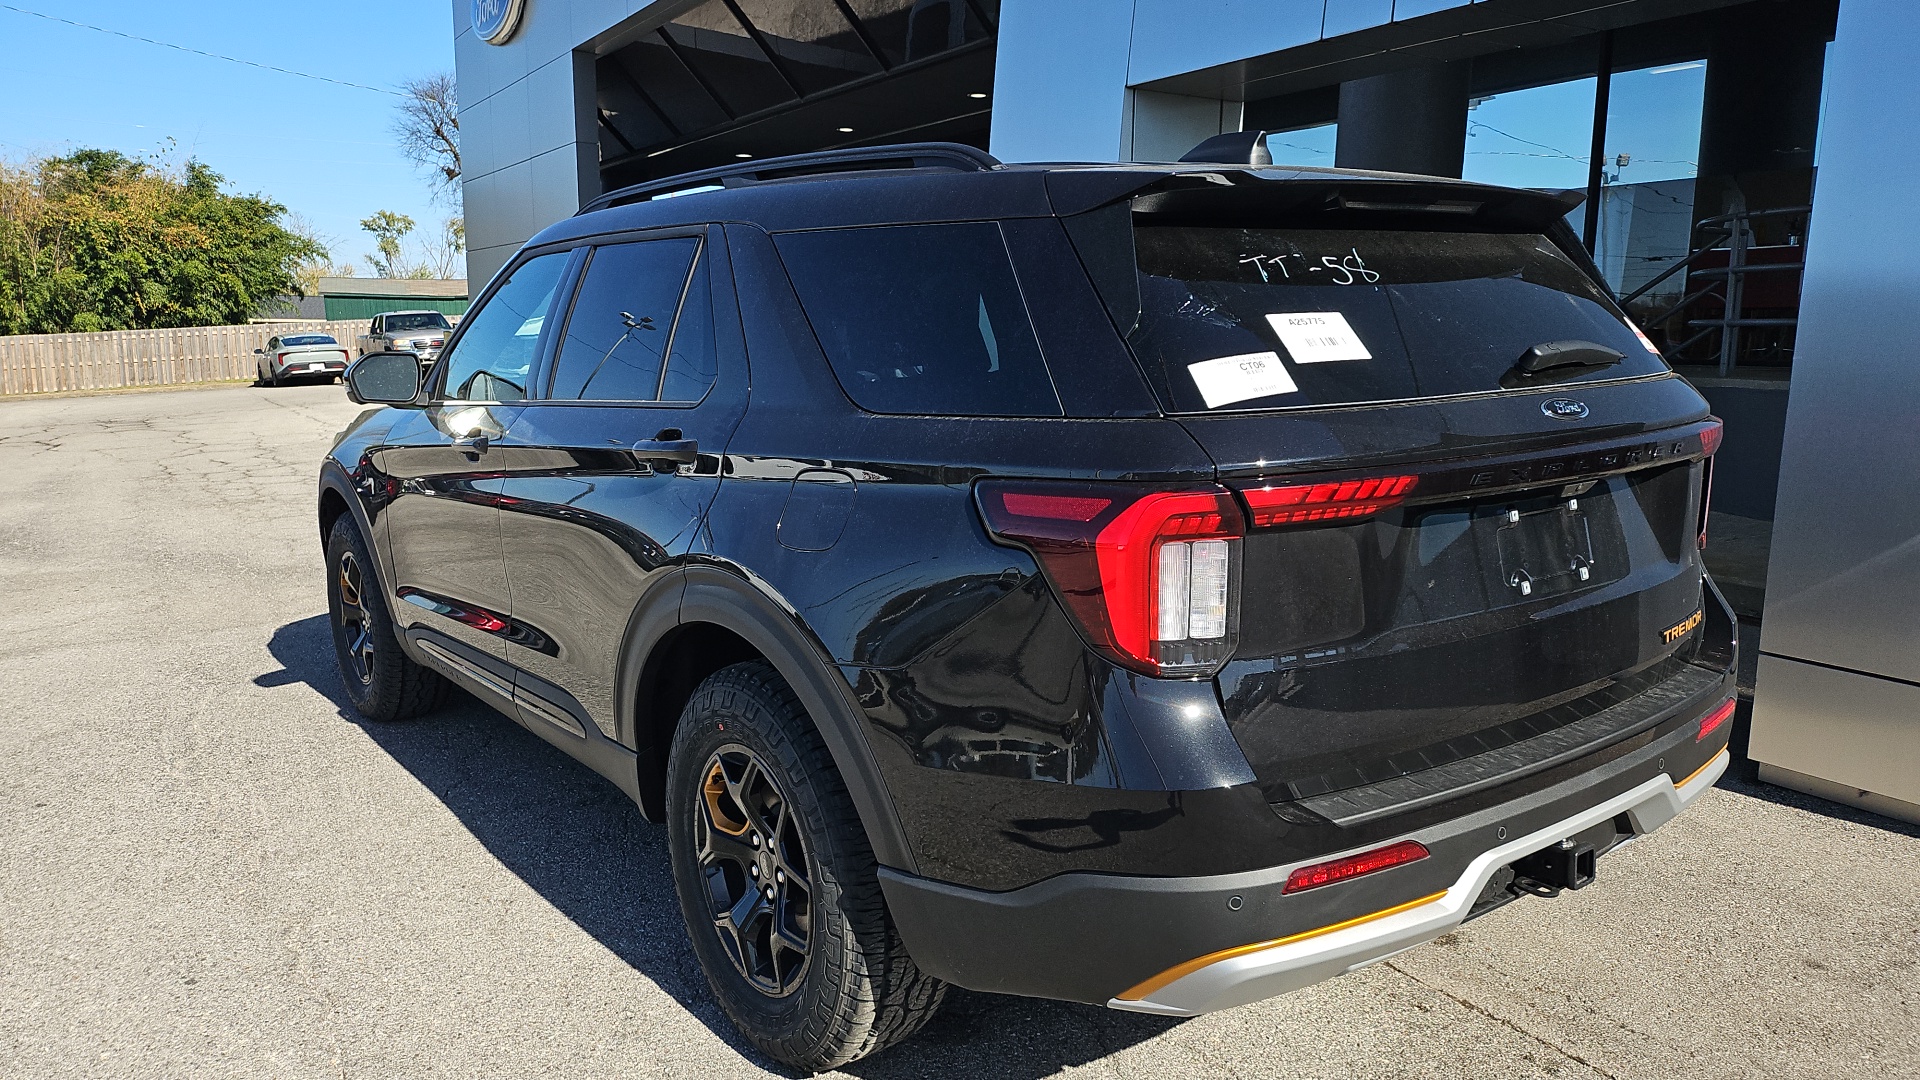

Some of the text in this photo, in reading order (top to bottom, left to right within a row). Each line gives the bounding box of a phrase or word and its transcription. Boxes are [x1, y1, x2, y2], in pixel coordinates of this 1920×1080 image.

[1288, 317, 1326, 326] A25775
[1239, 360, 1266, 372] CT06
[1469, 442, 1684, 487] EXPLORER
[1663, 609, 1702, 643] TREMOR
